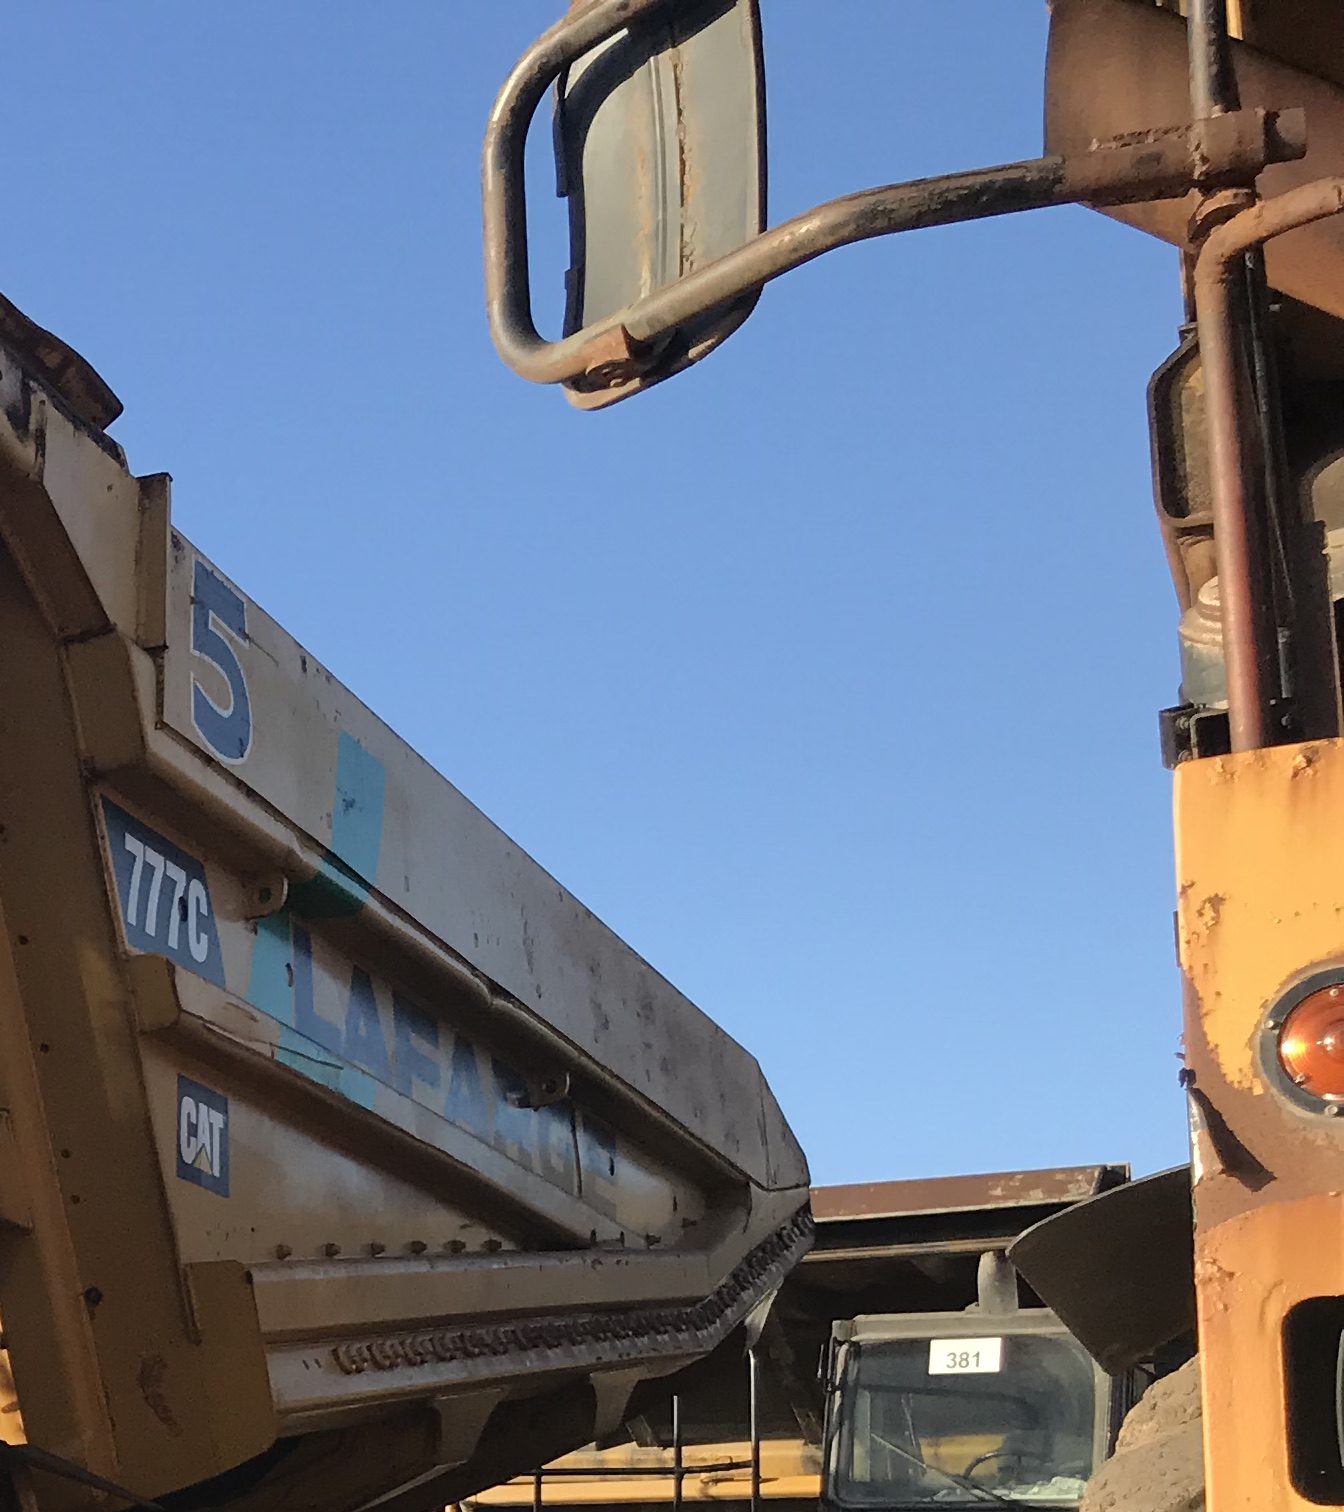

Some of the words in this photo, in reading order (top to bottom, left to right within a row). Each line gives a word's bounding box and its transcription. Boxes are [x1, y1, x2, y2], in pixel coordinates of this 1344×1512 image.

[190, 554, 252, 765] 5
[124, 832, 209, 963] 777C
[180, 1095, 225, 1179] CAT
[946, 1350, 981, 1369] 381
